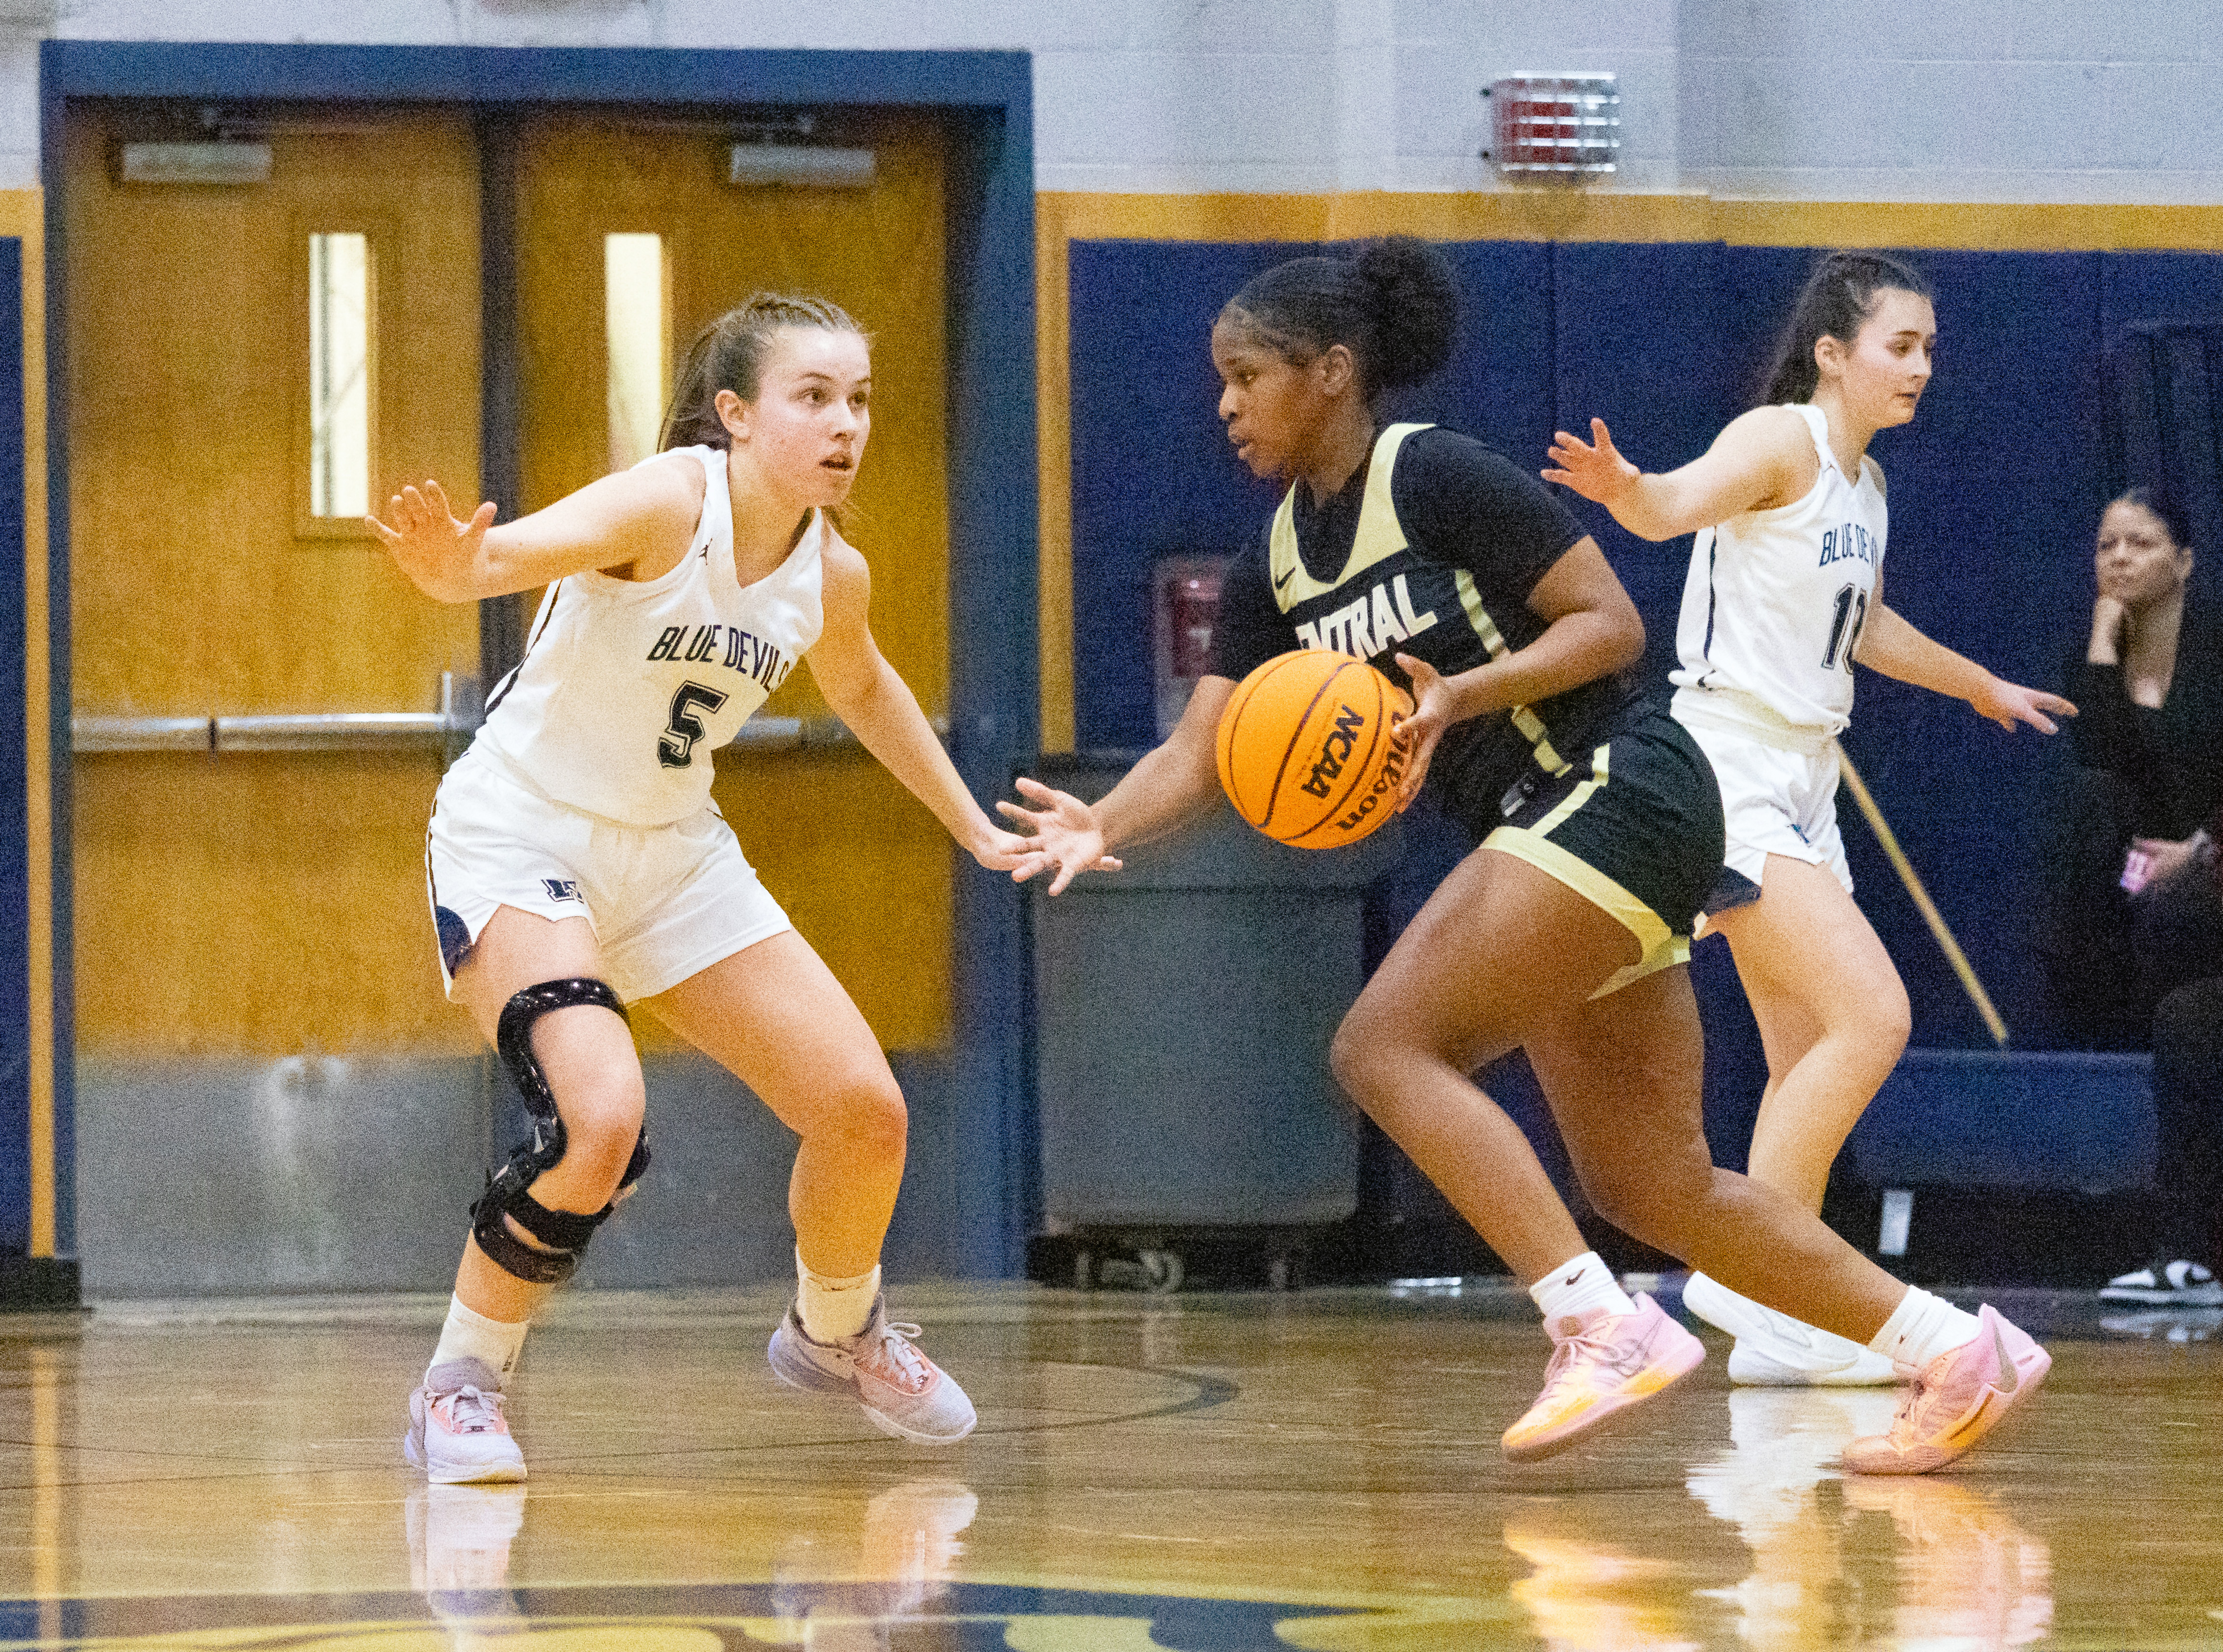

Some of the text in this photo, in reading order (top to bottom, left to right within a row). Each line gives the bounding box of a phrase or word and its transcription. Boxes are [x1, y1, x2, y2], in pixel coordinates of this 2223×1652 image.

[1819, 523, 1854, 567] BLUE
[646, 625, 722, 663] BLUE
[657, 680, 730, 769] 5
[1301, 704, 1365, 799] NCAA
